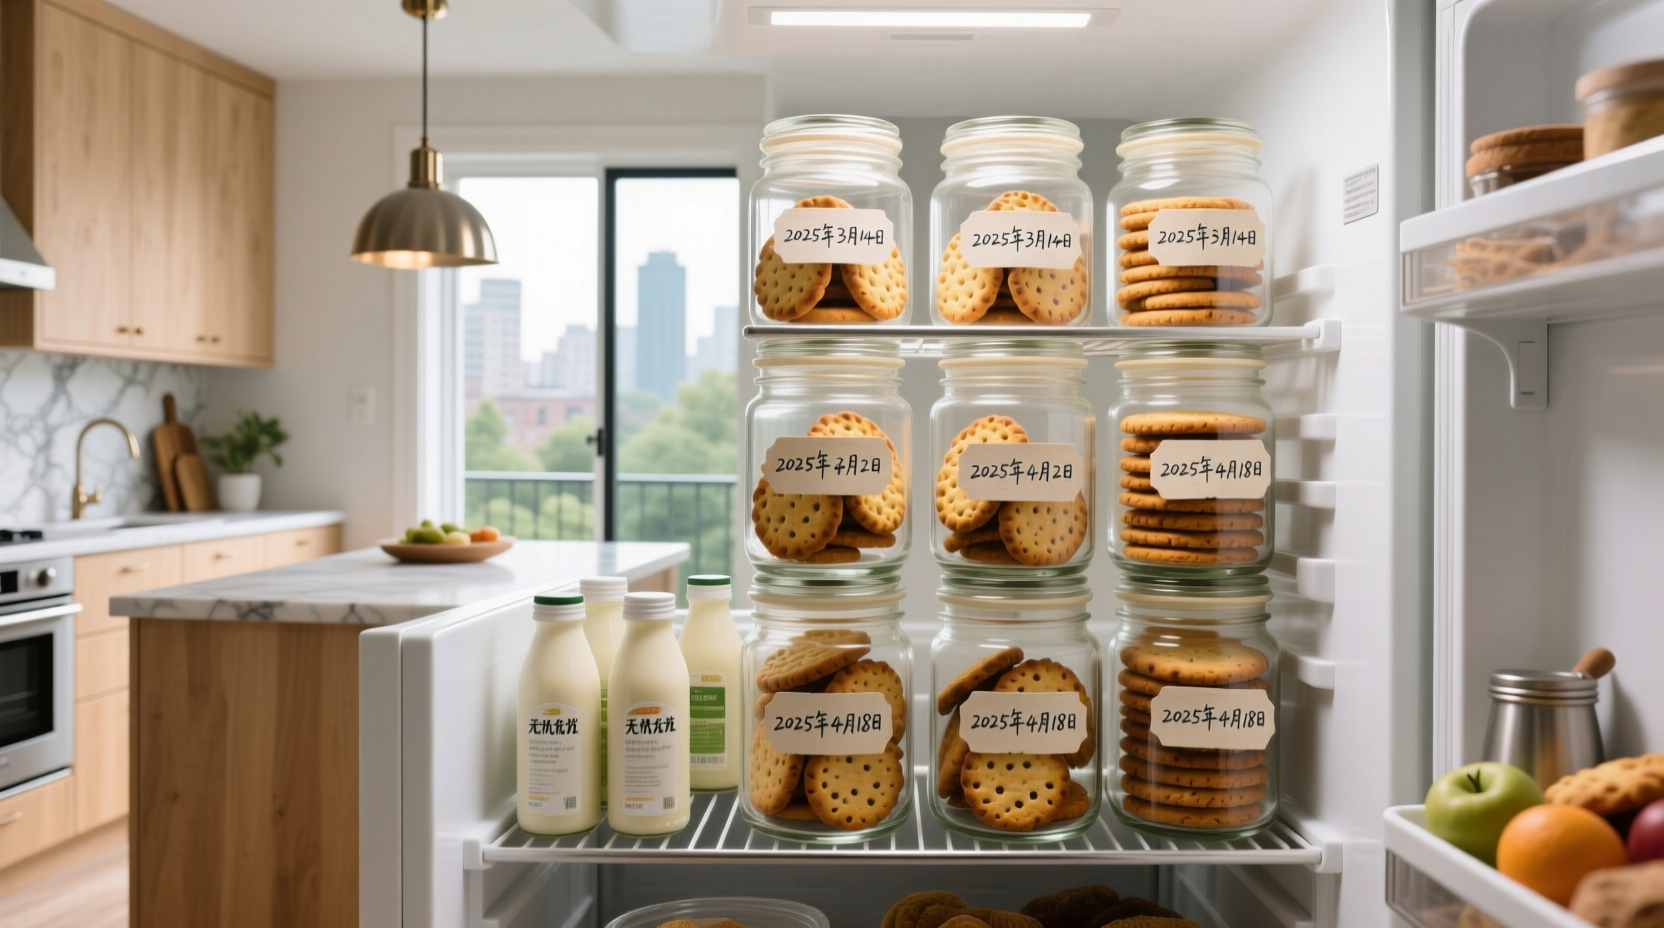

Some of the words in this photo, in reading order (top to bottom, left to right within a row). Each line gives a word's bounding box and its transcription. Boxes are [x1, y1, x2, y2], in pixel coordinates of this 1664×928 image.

[783, 221, 884, 249] 2025年3月14日
[972, 225, 1072, 253] 2025年3月14日
[1157, 223, 1256, 251] 2025年3月14日
[970, 458, 1073, 485] 2025年4月2日
[1160, 455, 1263, 483] 2025年4月18日
[773, 710, 882, 739] 2025年4月18日
[970, 708, 1077, 740] 2025年4月18日
[1161, 703, 1265, 730] 2025年4月18日
